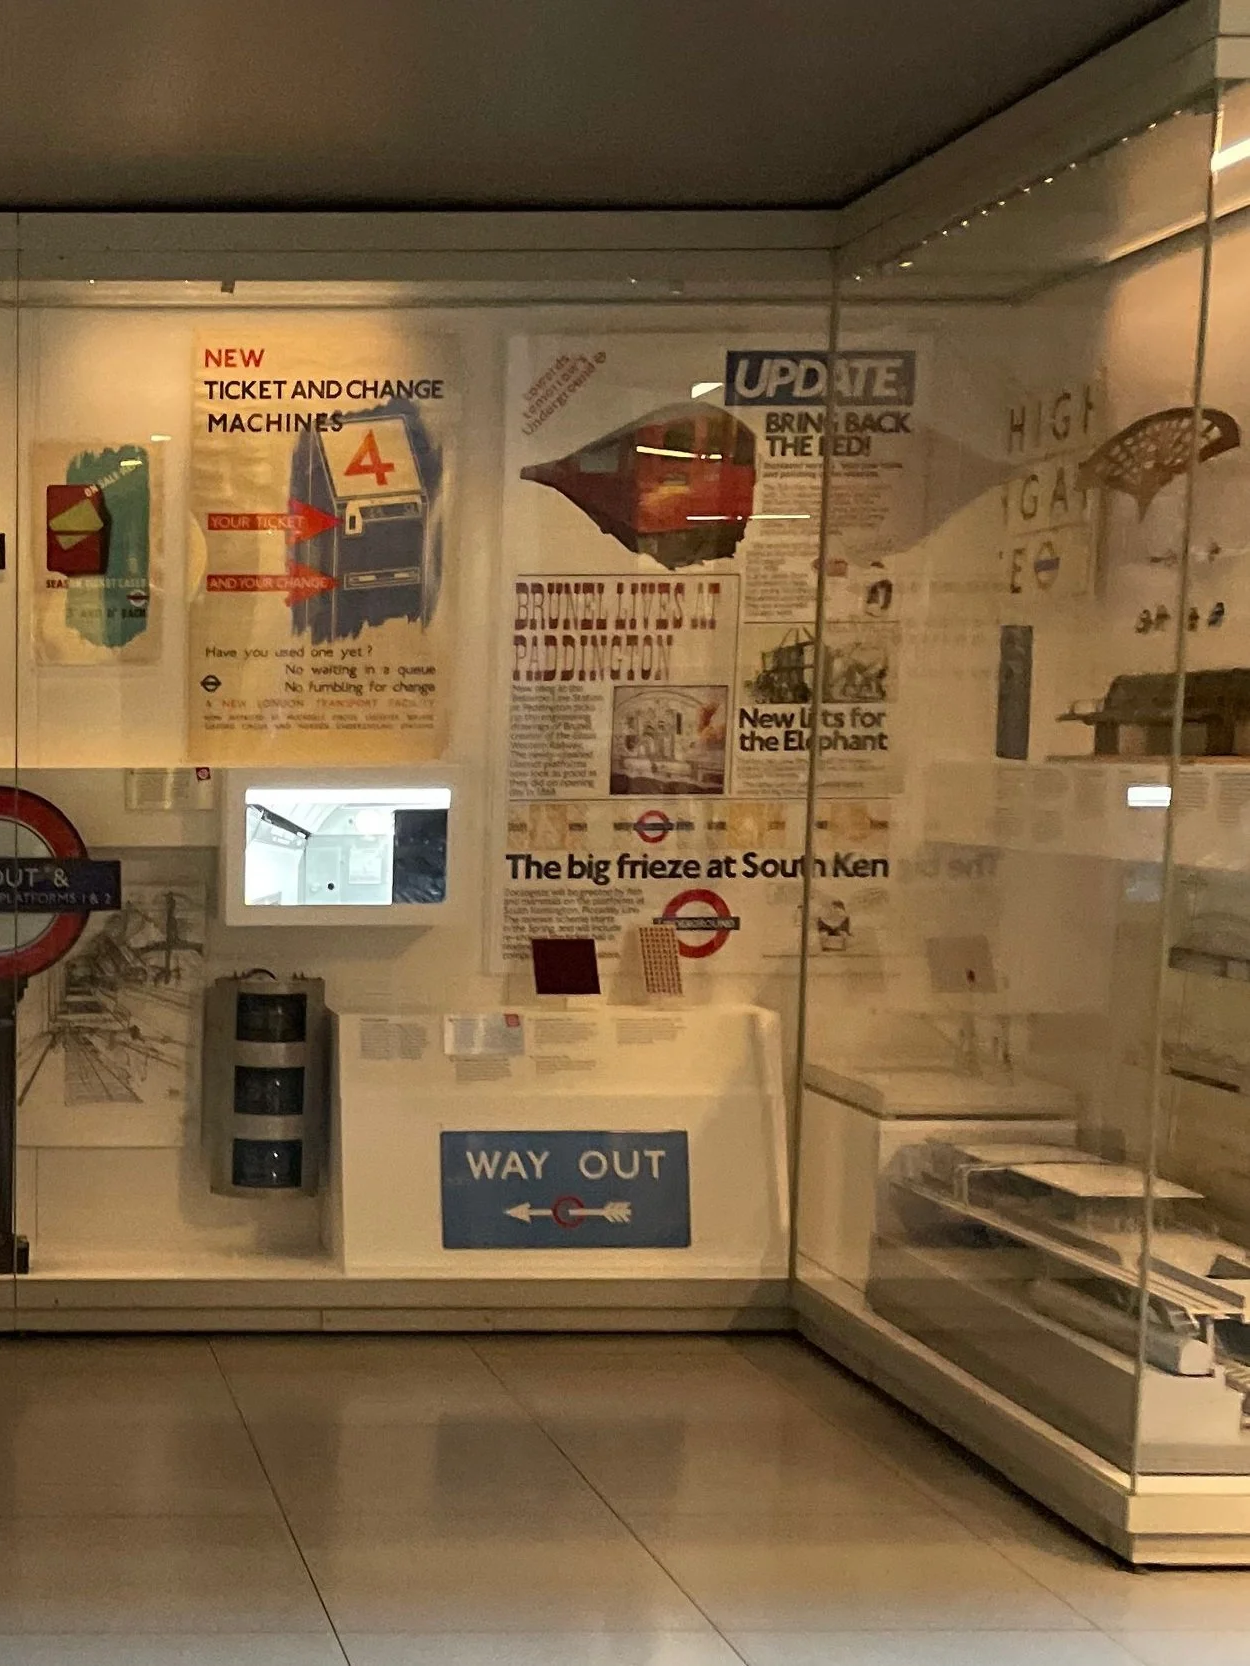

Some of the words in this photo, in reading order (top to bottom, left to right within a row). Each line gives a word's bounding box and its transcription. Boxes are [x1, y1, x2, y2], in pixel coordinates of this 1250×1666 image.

[204, 348, 265, 368] NEW
[204, 380, 287, 400] TICKET
[291, 380, 343, 399] AND
[346, 380, 444, 399] CHANGE
[208, 412, 343, 433] MACHINES
[765, 412, 839, 434] BRIN
[845, 411, 912, 433] BACK
[765, 436, 813, 457] THE
[344, 428, 395, 486] 4
[211, 516, 250, 529] YOUR
[257, 515, 305, 529] TICKET
[210, 579, 236, 590] AND
[277, 577, 328, 589] CHANGE
[515, 582, 608, 630] BRUNEL
[614, 582, 686, 630] LIVES
[205, 648, 237, 657] Have
[245, 649, 268, 660] you
[275, 648, 304, 658] used
[310, 649, 333, 657] one
[513, 634, 674, 682] PADDINGTON
[285, 665, 303, 675] No
[311, 664, 357, 678] waiting
[365, 665, 376, 675] in
[383, 667, 390, 675] a
[397, 666, 436, 678] queue
[285, 682, 303, 693] No
[309, 681, 363, 695] fumbling
[369, 681, 387, 693] for
[392, 681, 436, 695] change
[739, 708, 795, 728] New
[851, 706, 887, 728] for
[740, 731, 779, 751] the
[53, 868, 70, 888] &
[505, 854, 561, 879] The
[567, 853, 611, 886] big
[618, 853, 700, 879] frieze
[707, 855, 736, 879] at
[832, 852, 890, 879] Ken
[0, 892, 75, 904] PLATFORMS
[465, 1150, 549, 1180] WAY
[578, 1150, 666, 1180] OUT
